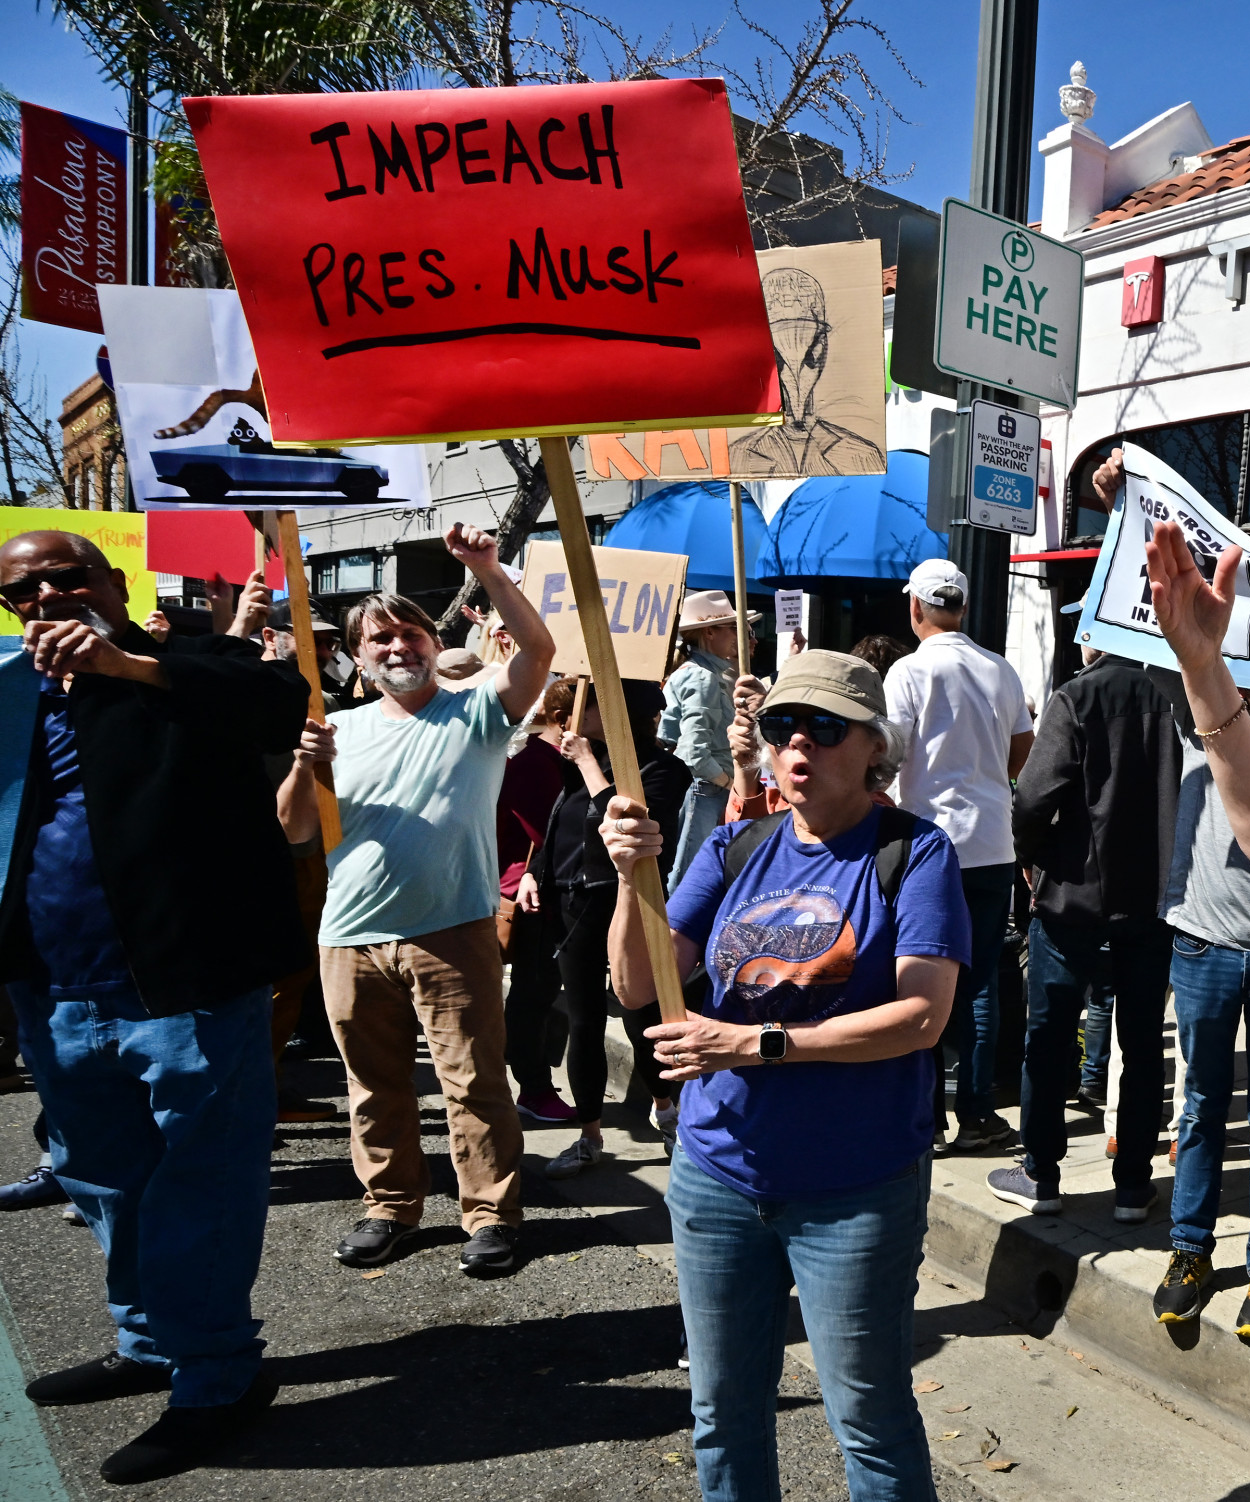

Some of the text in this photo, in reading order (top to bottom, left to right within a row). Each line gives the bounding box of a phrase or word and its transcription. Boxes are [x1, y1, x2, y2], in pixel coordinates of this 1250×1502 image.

[310, 105, 623, 202] IMPEACH
[34, 134, 97, 292] Pasadena
[97, 151, 116, 283] SYMPHONY
[302, 226, 684, 327] PRES. Musk
[981, 263, 1049, 316] PAY
[966, 296, 1058, 359] HERE
[977, 432, 1035, 453] PAY WITH THE APP
[980, 441, 1031, 463] PASSPORT
[983, 453, 1028, 473] PARKING
[992, 473, 1017, 487] ZONE
[986, 483, 1022, 503] 6263
[1139, 495, 1170, 521] GOES
[1131, 606, 1150, 623] IN
[751, 893, 766, 903] OF
[768, 888, 791, 898] THE
